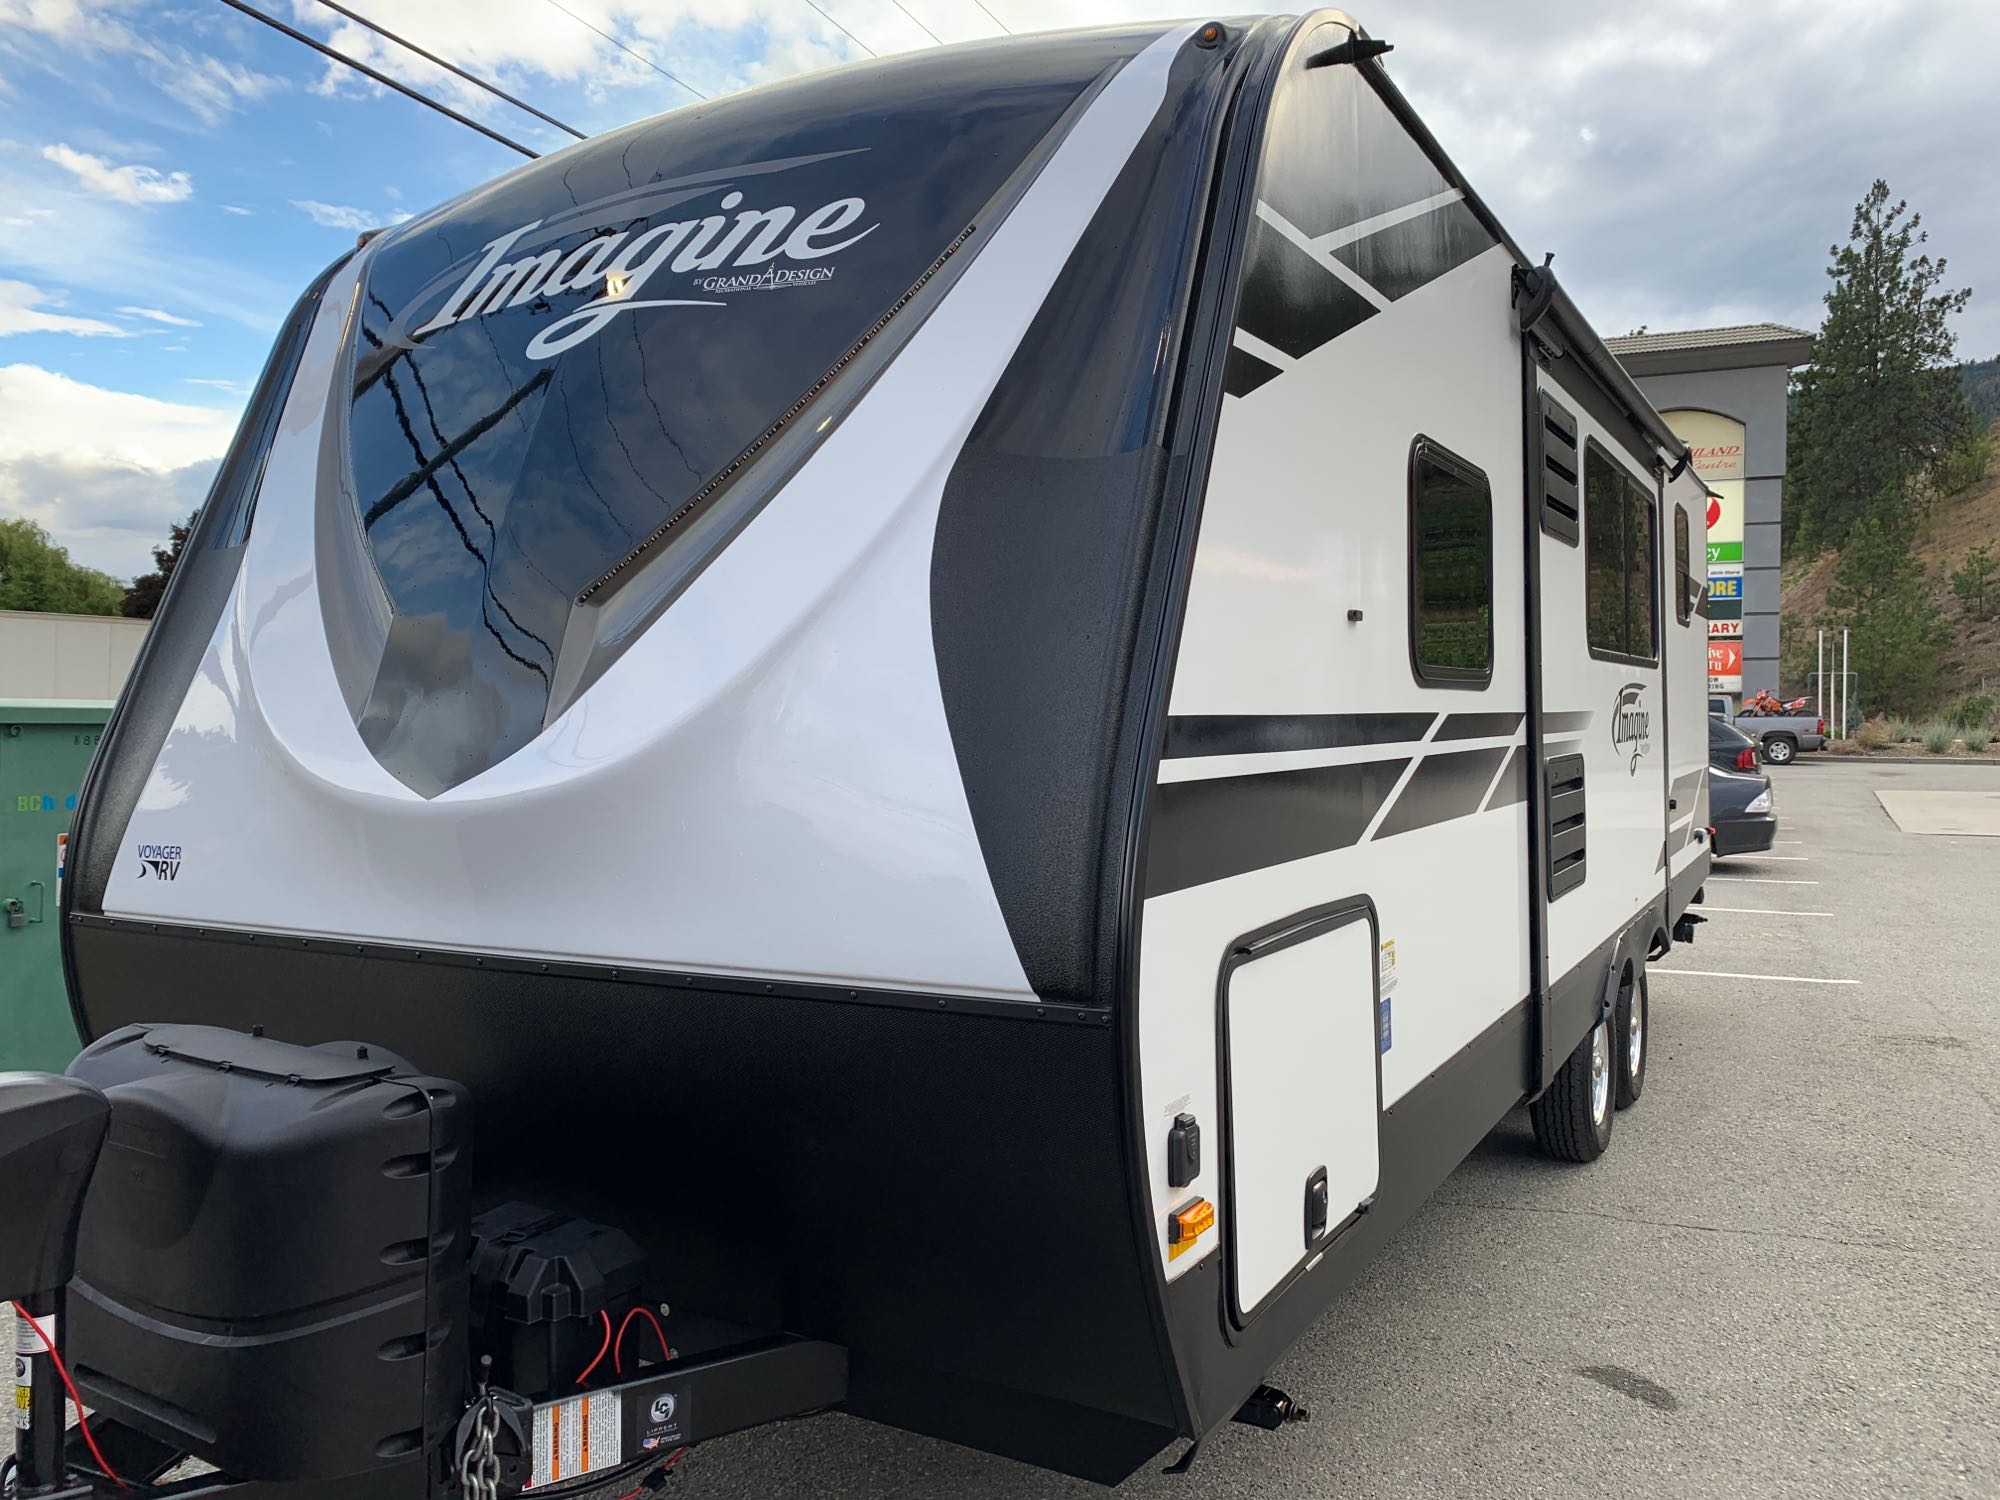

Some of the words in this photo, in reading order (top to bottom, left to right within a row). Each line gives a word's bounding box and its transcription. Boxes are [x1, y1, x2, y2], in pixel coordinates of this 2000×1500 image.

[412, 191, 880, 361] Imagine
[692, 278, 704, 286] BY
[703, 273, 762, 291] GRAND
[774, 266, 836, 283] DESIGN
[1616, 687, 1650, 777] Imagine
[137, 844, 182, 860] VOYAGER
[158, 860, 181, 881] RV
[646, 1422, 678, 1435] LIPPERT
